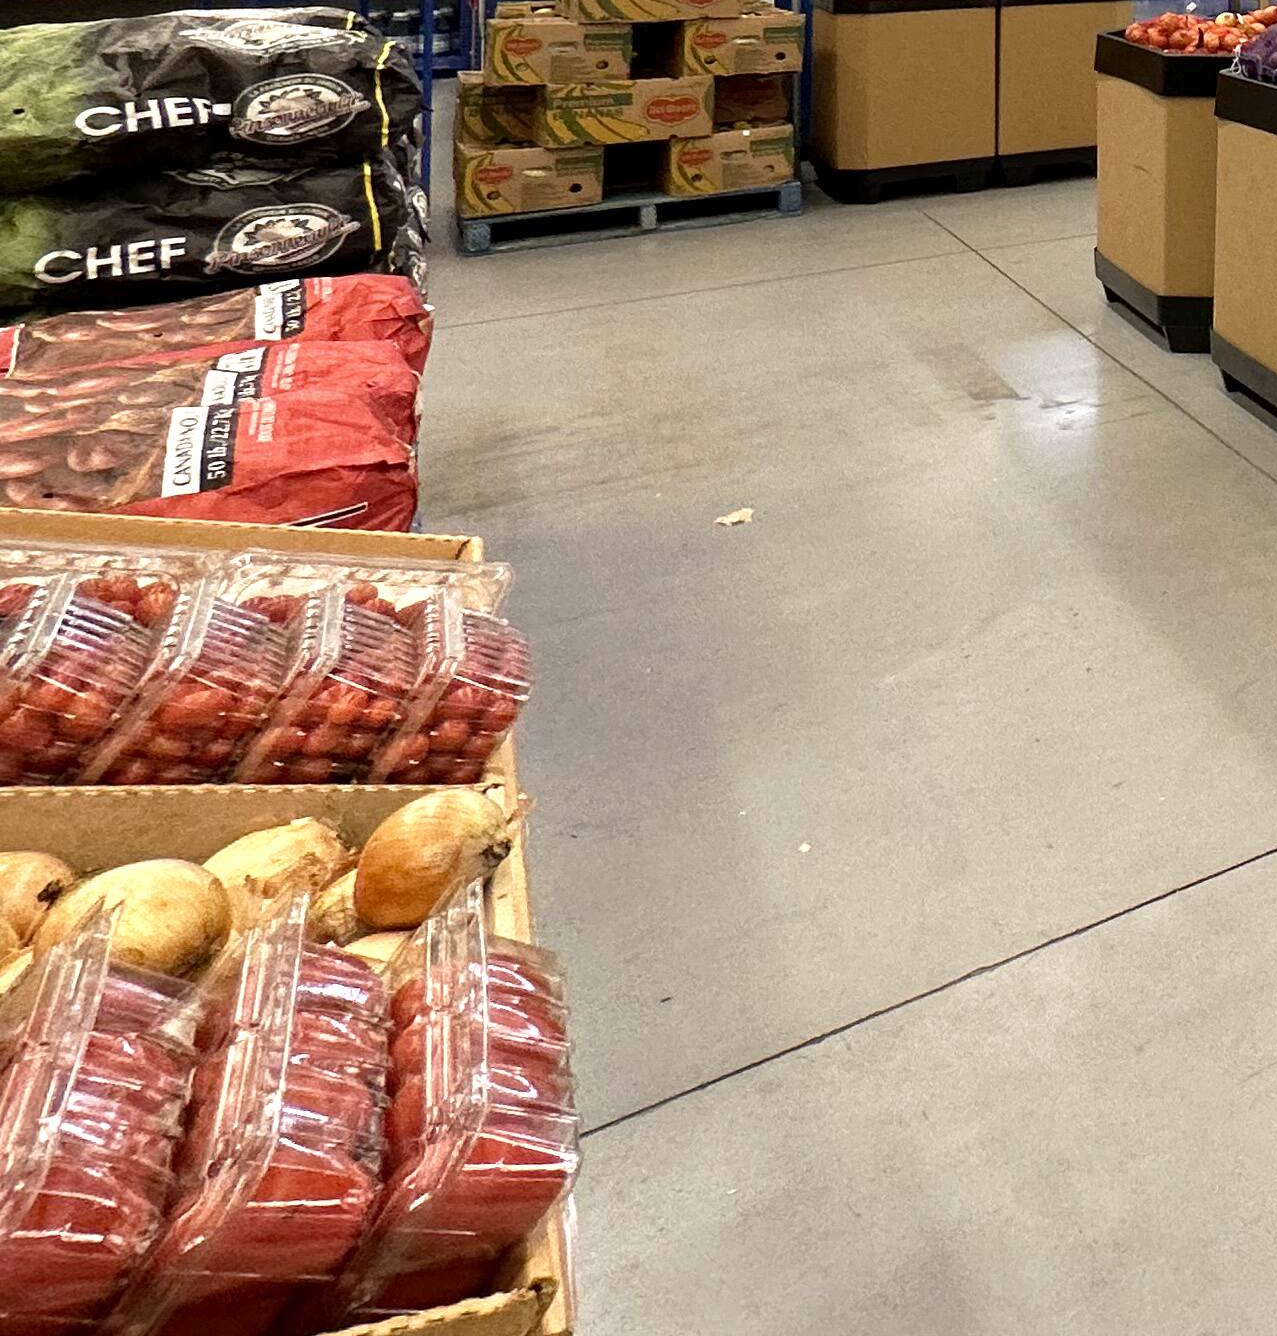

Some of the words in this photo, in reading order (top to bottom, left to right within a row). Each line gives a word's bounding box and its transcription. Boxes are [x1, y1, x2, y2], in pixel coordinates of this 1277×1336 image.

[75, 97, 231, 136] CHEF
[553, 98, 614, 110] Premium
[34, 237, 186, 284] CHEF
[207, 462, 227, 480] 50
